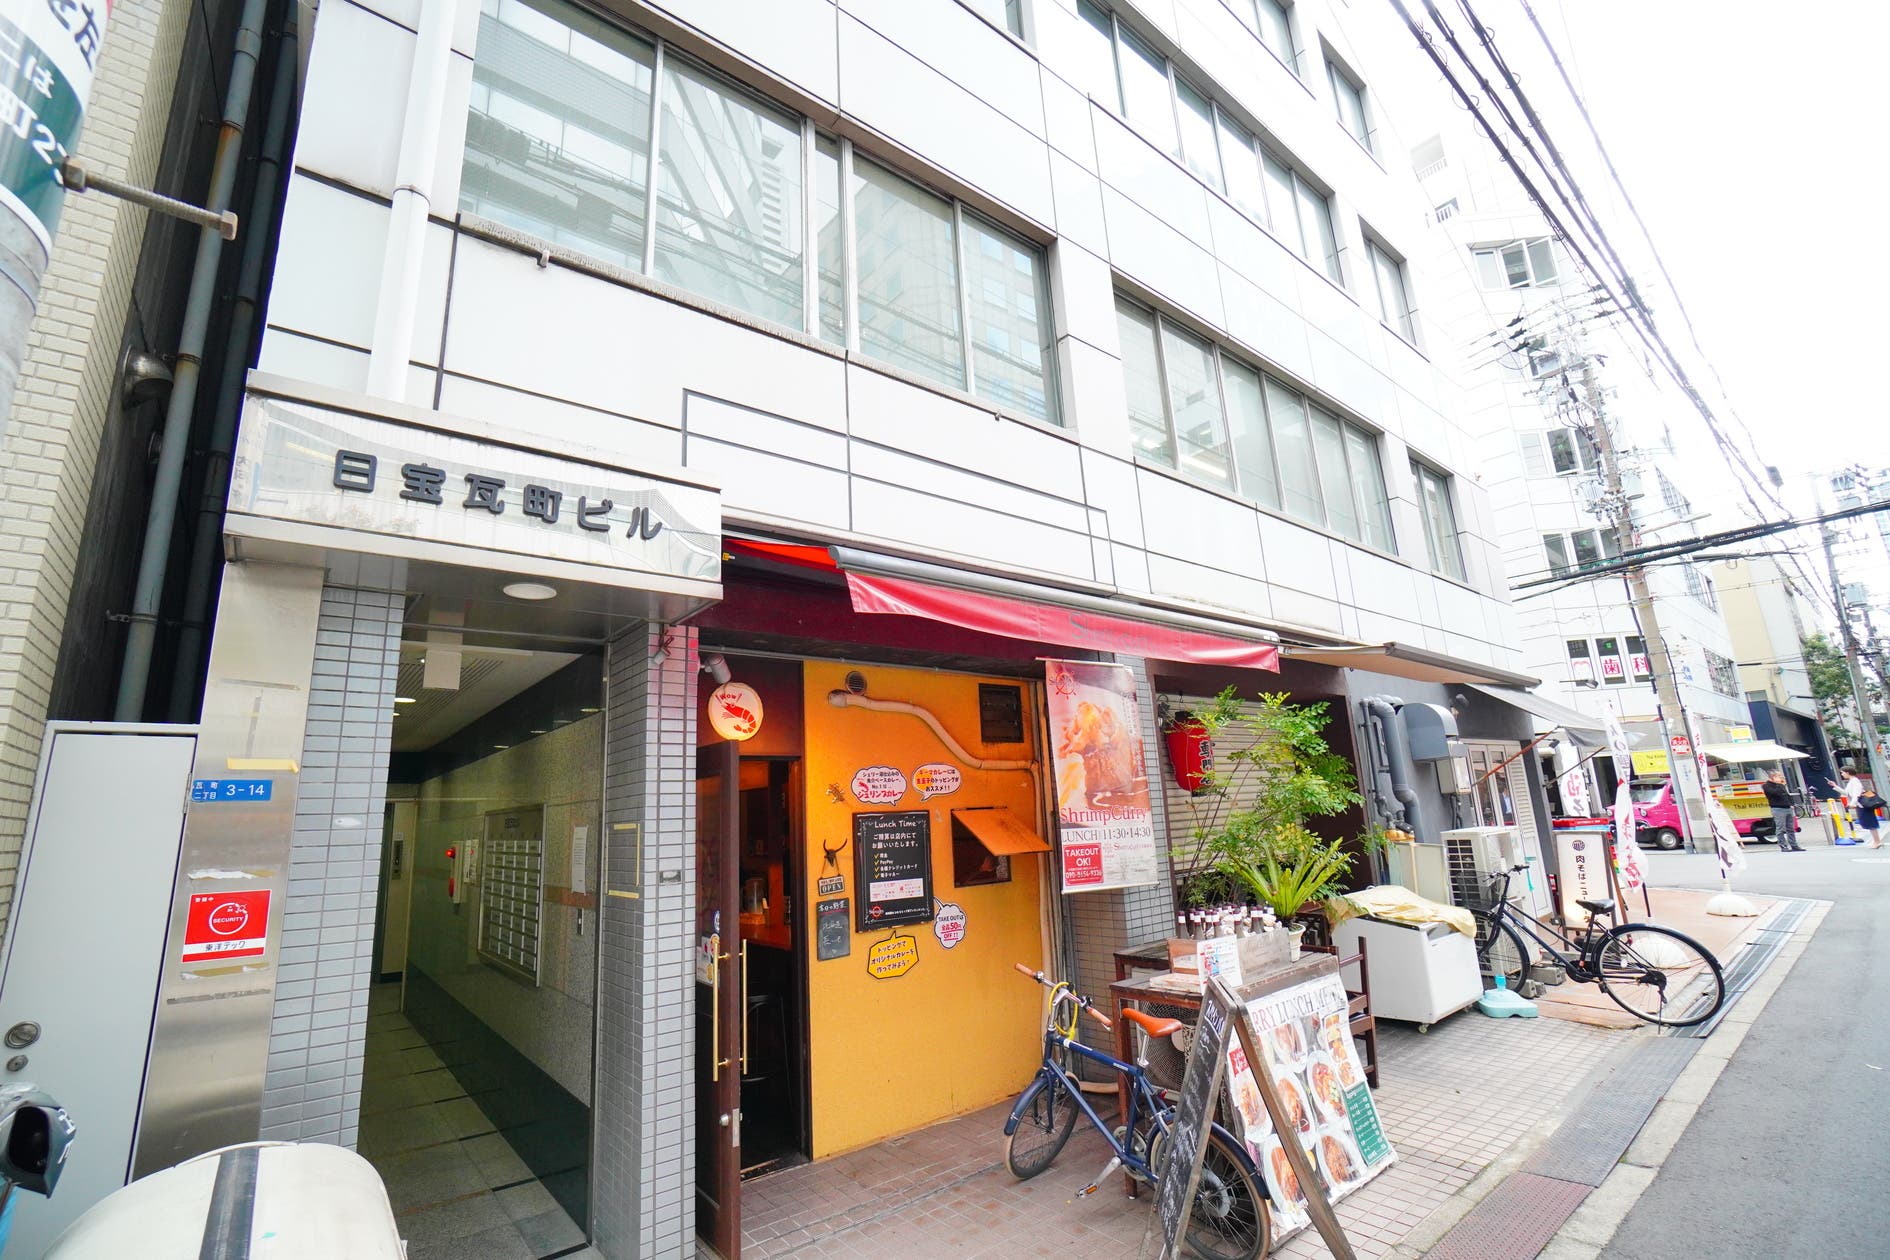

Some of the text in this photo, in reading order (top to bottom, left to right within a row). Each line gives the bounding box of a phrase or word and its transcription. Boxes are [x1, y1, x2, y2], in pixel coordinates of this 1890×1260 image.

[333, 449, 663, 540] 日宝瓦町ビル
[226, 784, 265, 796] 3-14
[874, 819, 917, 828] Lunch Time
[1061, 829, 1098, 842] LUNCH
[1065, 848, 1099, 857] TAKEOUT
[1076, 858, 1091, 867] OK!
[821, 884, 841, 894] OPEN
[212, 917, 244, 925] SECURITY
[205, 940, 246, 951] 東洋テック
